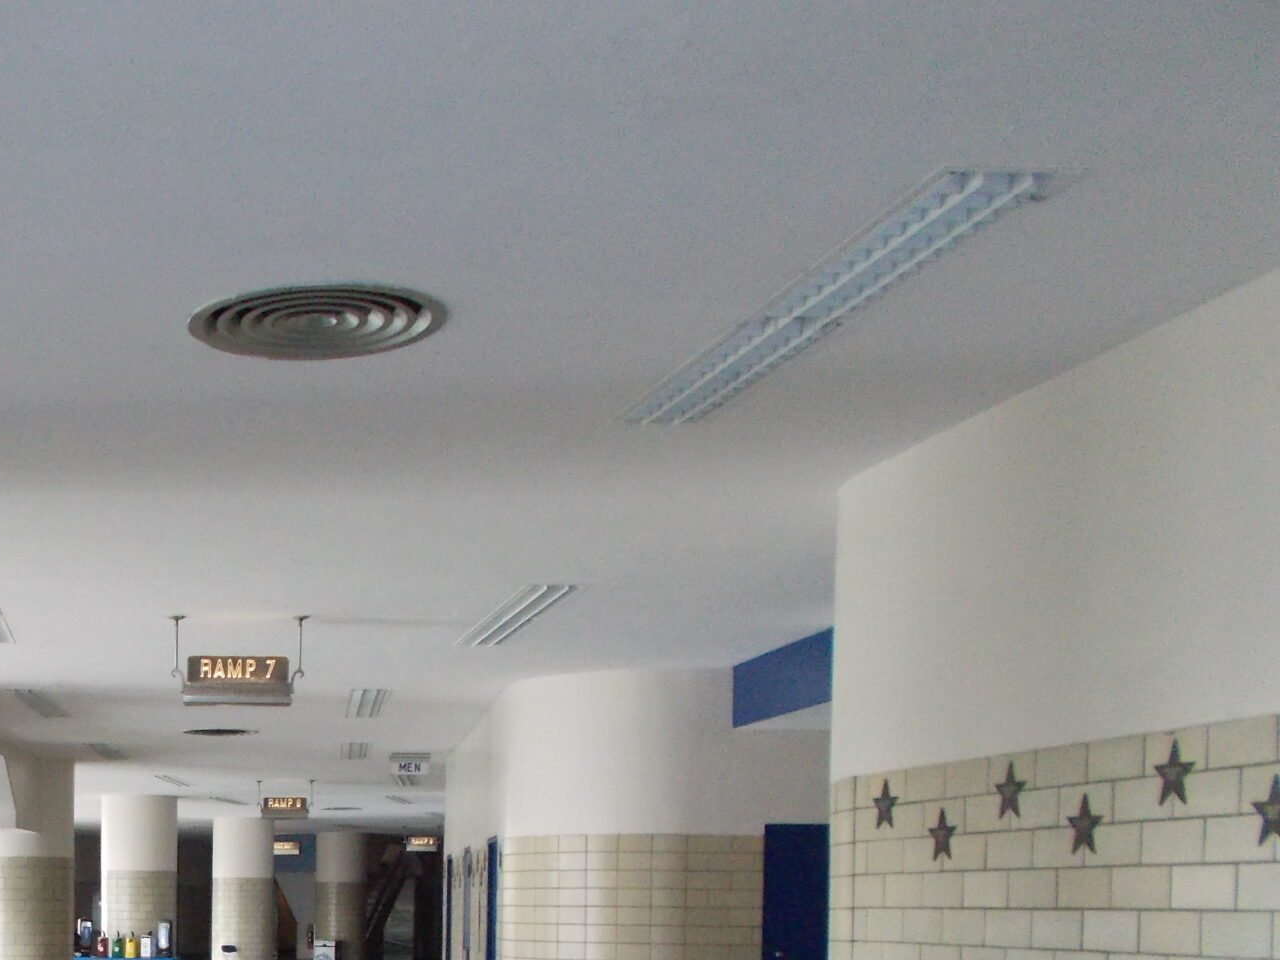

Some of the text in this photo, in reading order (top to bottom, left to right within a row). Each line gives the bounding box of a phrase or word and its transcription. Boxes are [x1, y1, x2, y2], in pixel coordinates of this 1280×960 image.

[200, 658, 276, 679] RAMP 7
[399, 762, 421, 773] MEN
[268, 798, 293, 808] RAMP
